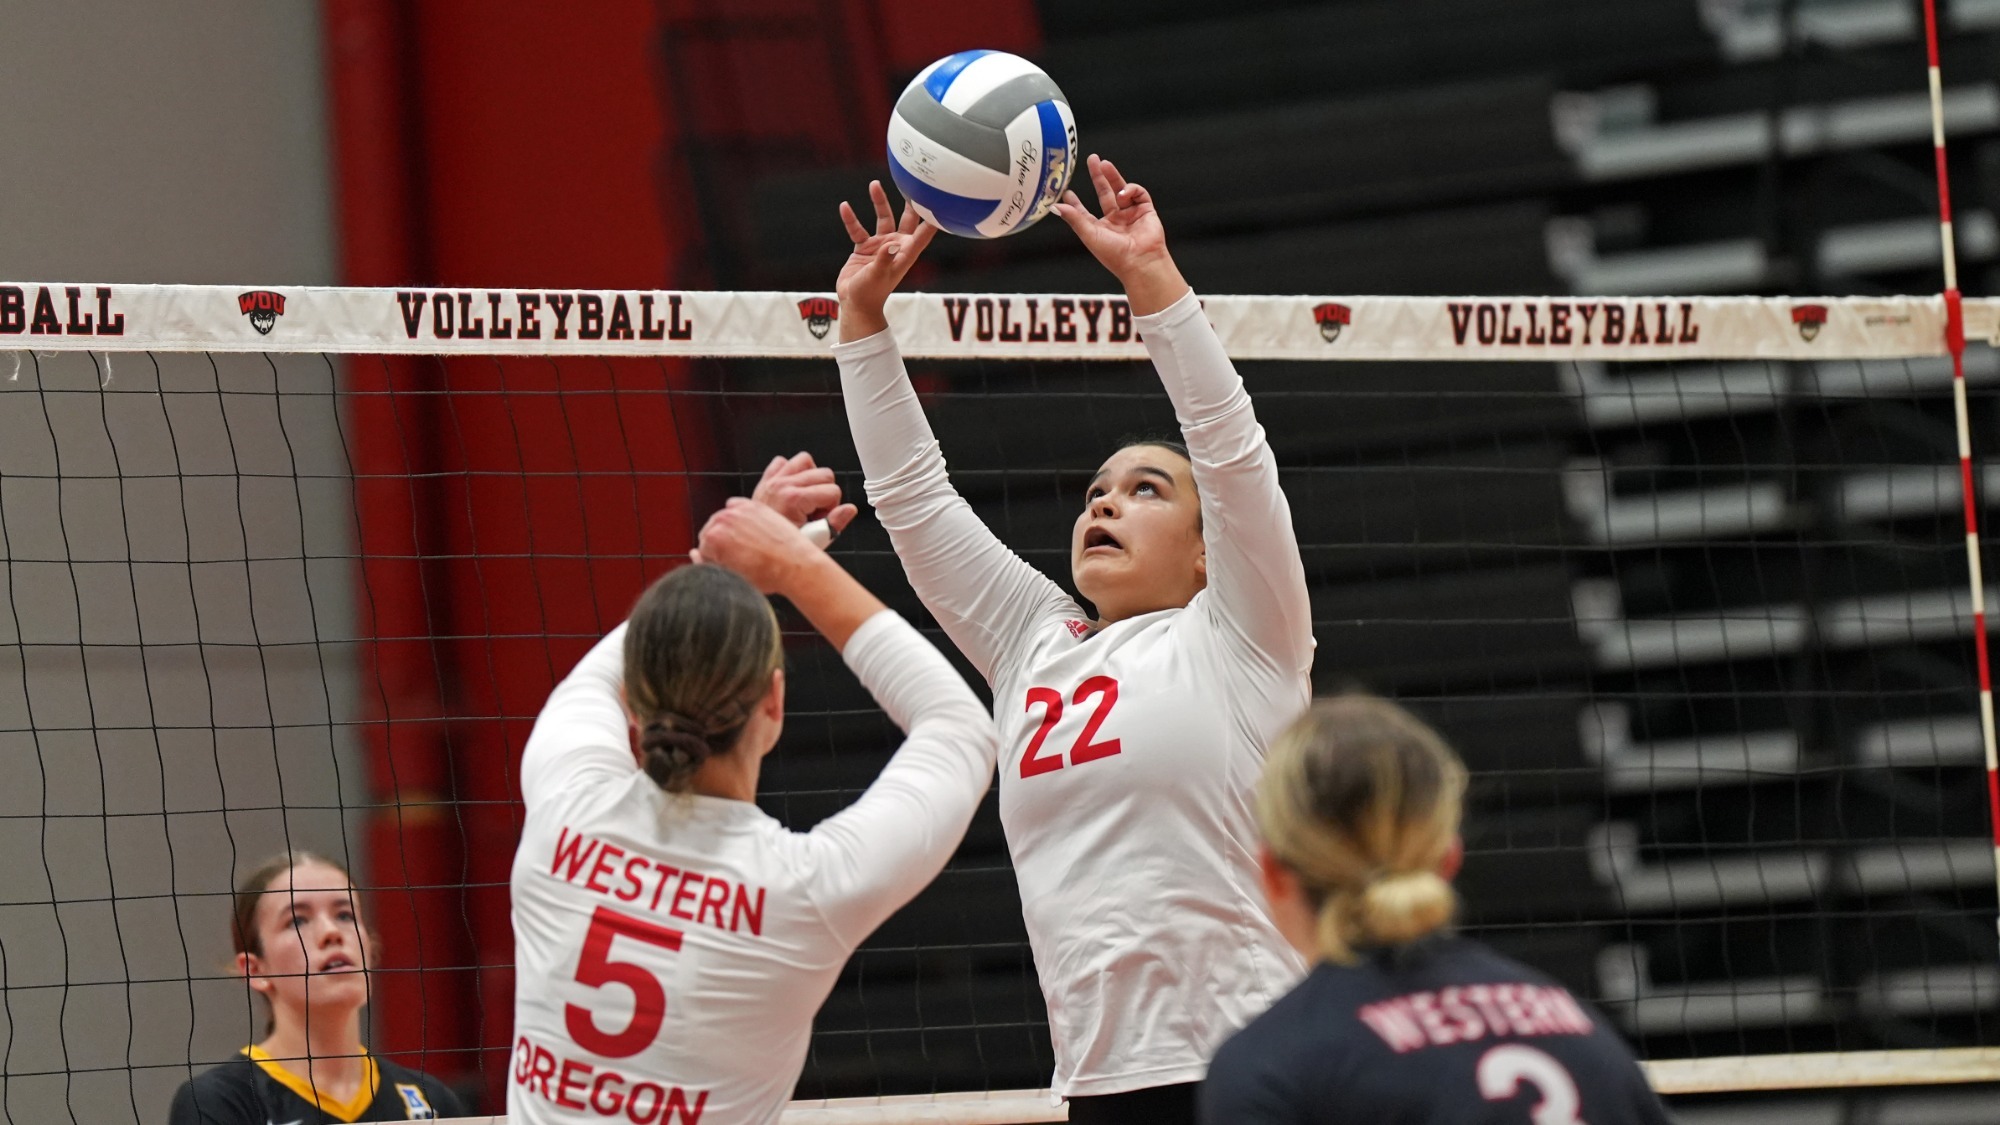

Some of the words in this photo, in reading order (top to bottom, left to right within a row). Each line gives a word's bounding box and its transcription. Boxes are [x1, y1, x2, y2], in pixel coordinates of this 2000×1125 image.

[1016, 139, 1038, 186] Super
[999, 190, 1026, 227] Touch
[0, 286, 125, 336] BALL
[238, 291, 286, 316] WOU
[396, 291, 692, 341] VOLLEYBALL
[797, 297, 840, 321] WOU
[943, 298, 1214, 343] VOLLEYB
[1447, 303, 1700, 345] VOLLEYBALL
[1019, 675, 1122, 779] 22
[551, 826, 766, 936] WESTERN
[564, 905, 684, 1059] 5
[1357, 982, 1595, 1054] WESTERN
[515, 1036, 709, 1125] OREGON
[1475, 1042, 1592, 1125] 3
